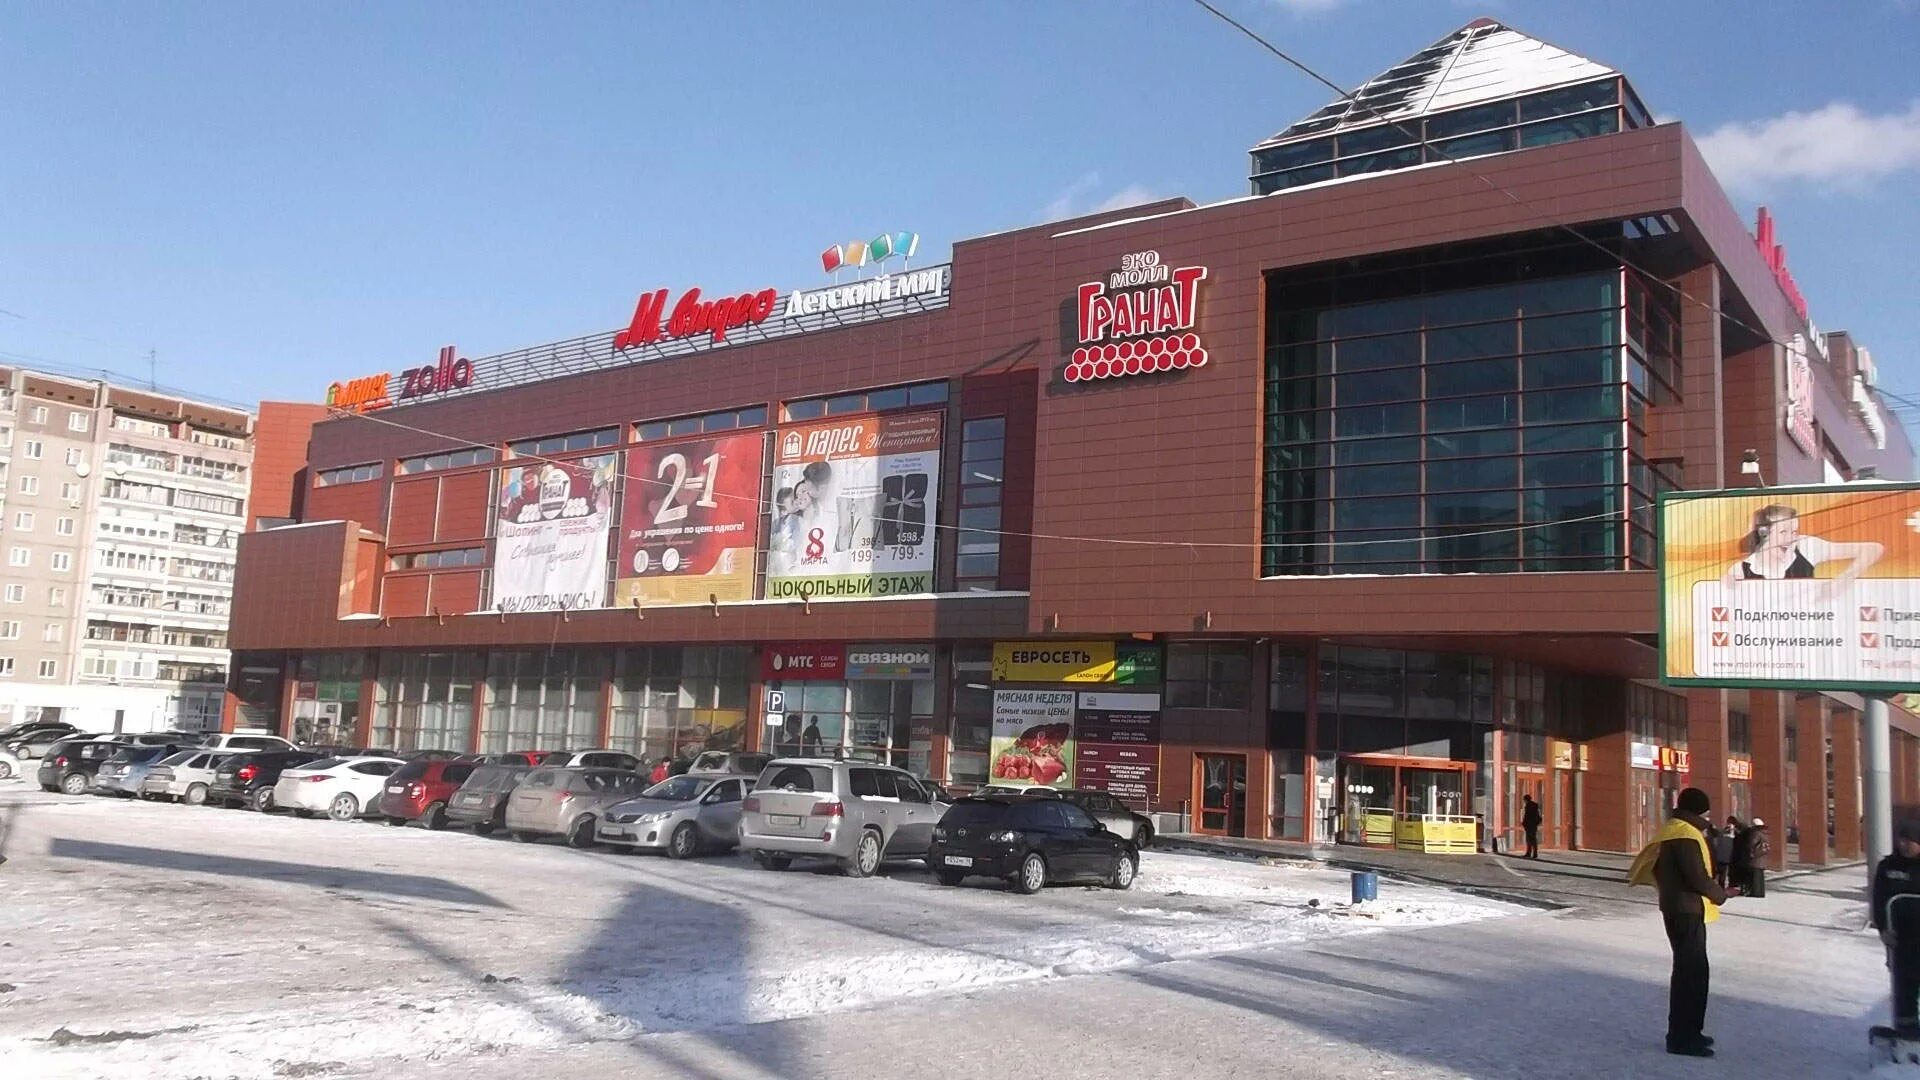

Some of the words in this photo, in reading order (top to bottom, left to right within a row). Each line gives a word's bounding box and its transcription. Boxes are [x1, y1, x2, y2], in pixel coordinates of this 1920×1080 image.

[1122, 251, 1159, 270] ЭКО
[1110, 265, 1168, 288] МОЛЛ
[783, 274, 891, 317] Детский
[895, 268, 951, 298] мир
[1078, 266, 1207, 343] ГРАНАТ
[400, 345, 472, 399] zolla
[684, 526, 694, 534] по
[805, 527, 825, 560] 8
[773, 575, 872, 598] ЦОКОЛЬНЫЙ
[878, 575, 925, 594] ЭТАЖ
[1734, 608, 1835, 623] Подключение
[1734, 633, 1844, 650] Обслуживание
[788, 655, 814, 668] МТС
[850, 649, 930, 665] СВЯЗНОЙ
[1011, 651, 1091, 664] ЕВРОСЕТЬ
[772, 693, 782, 710] P
[996, 693, 1034, 703] МЯСНАЯ
[1035, 693, 1073, 705] НЕДЕЛЯ
[1047, 707, 1070, 717] ЦЕНЫ
